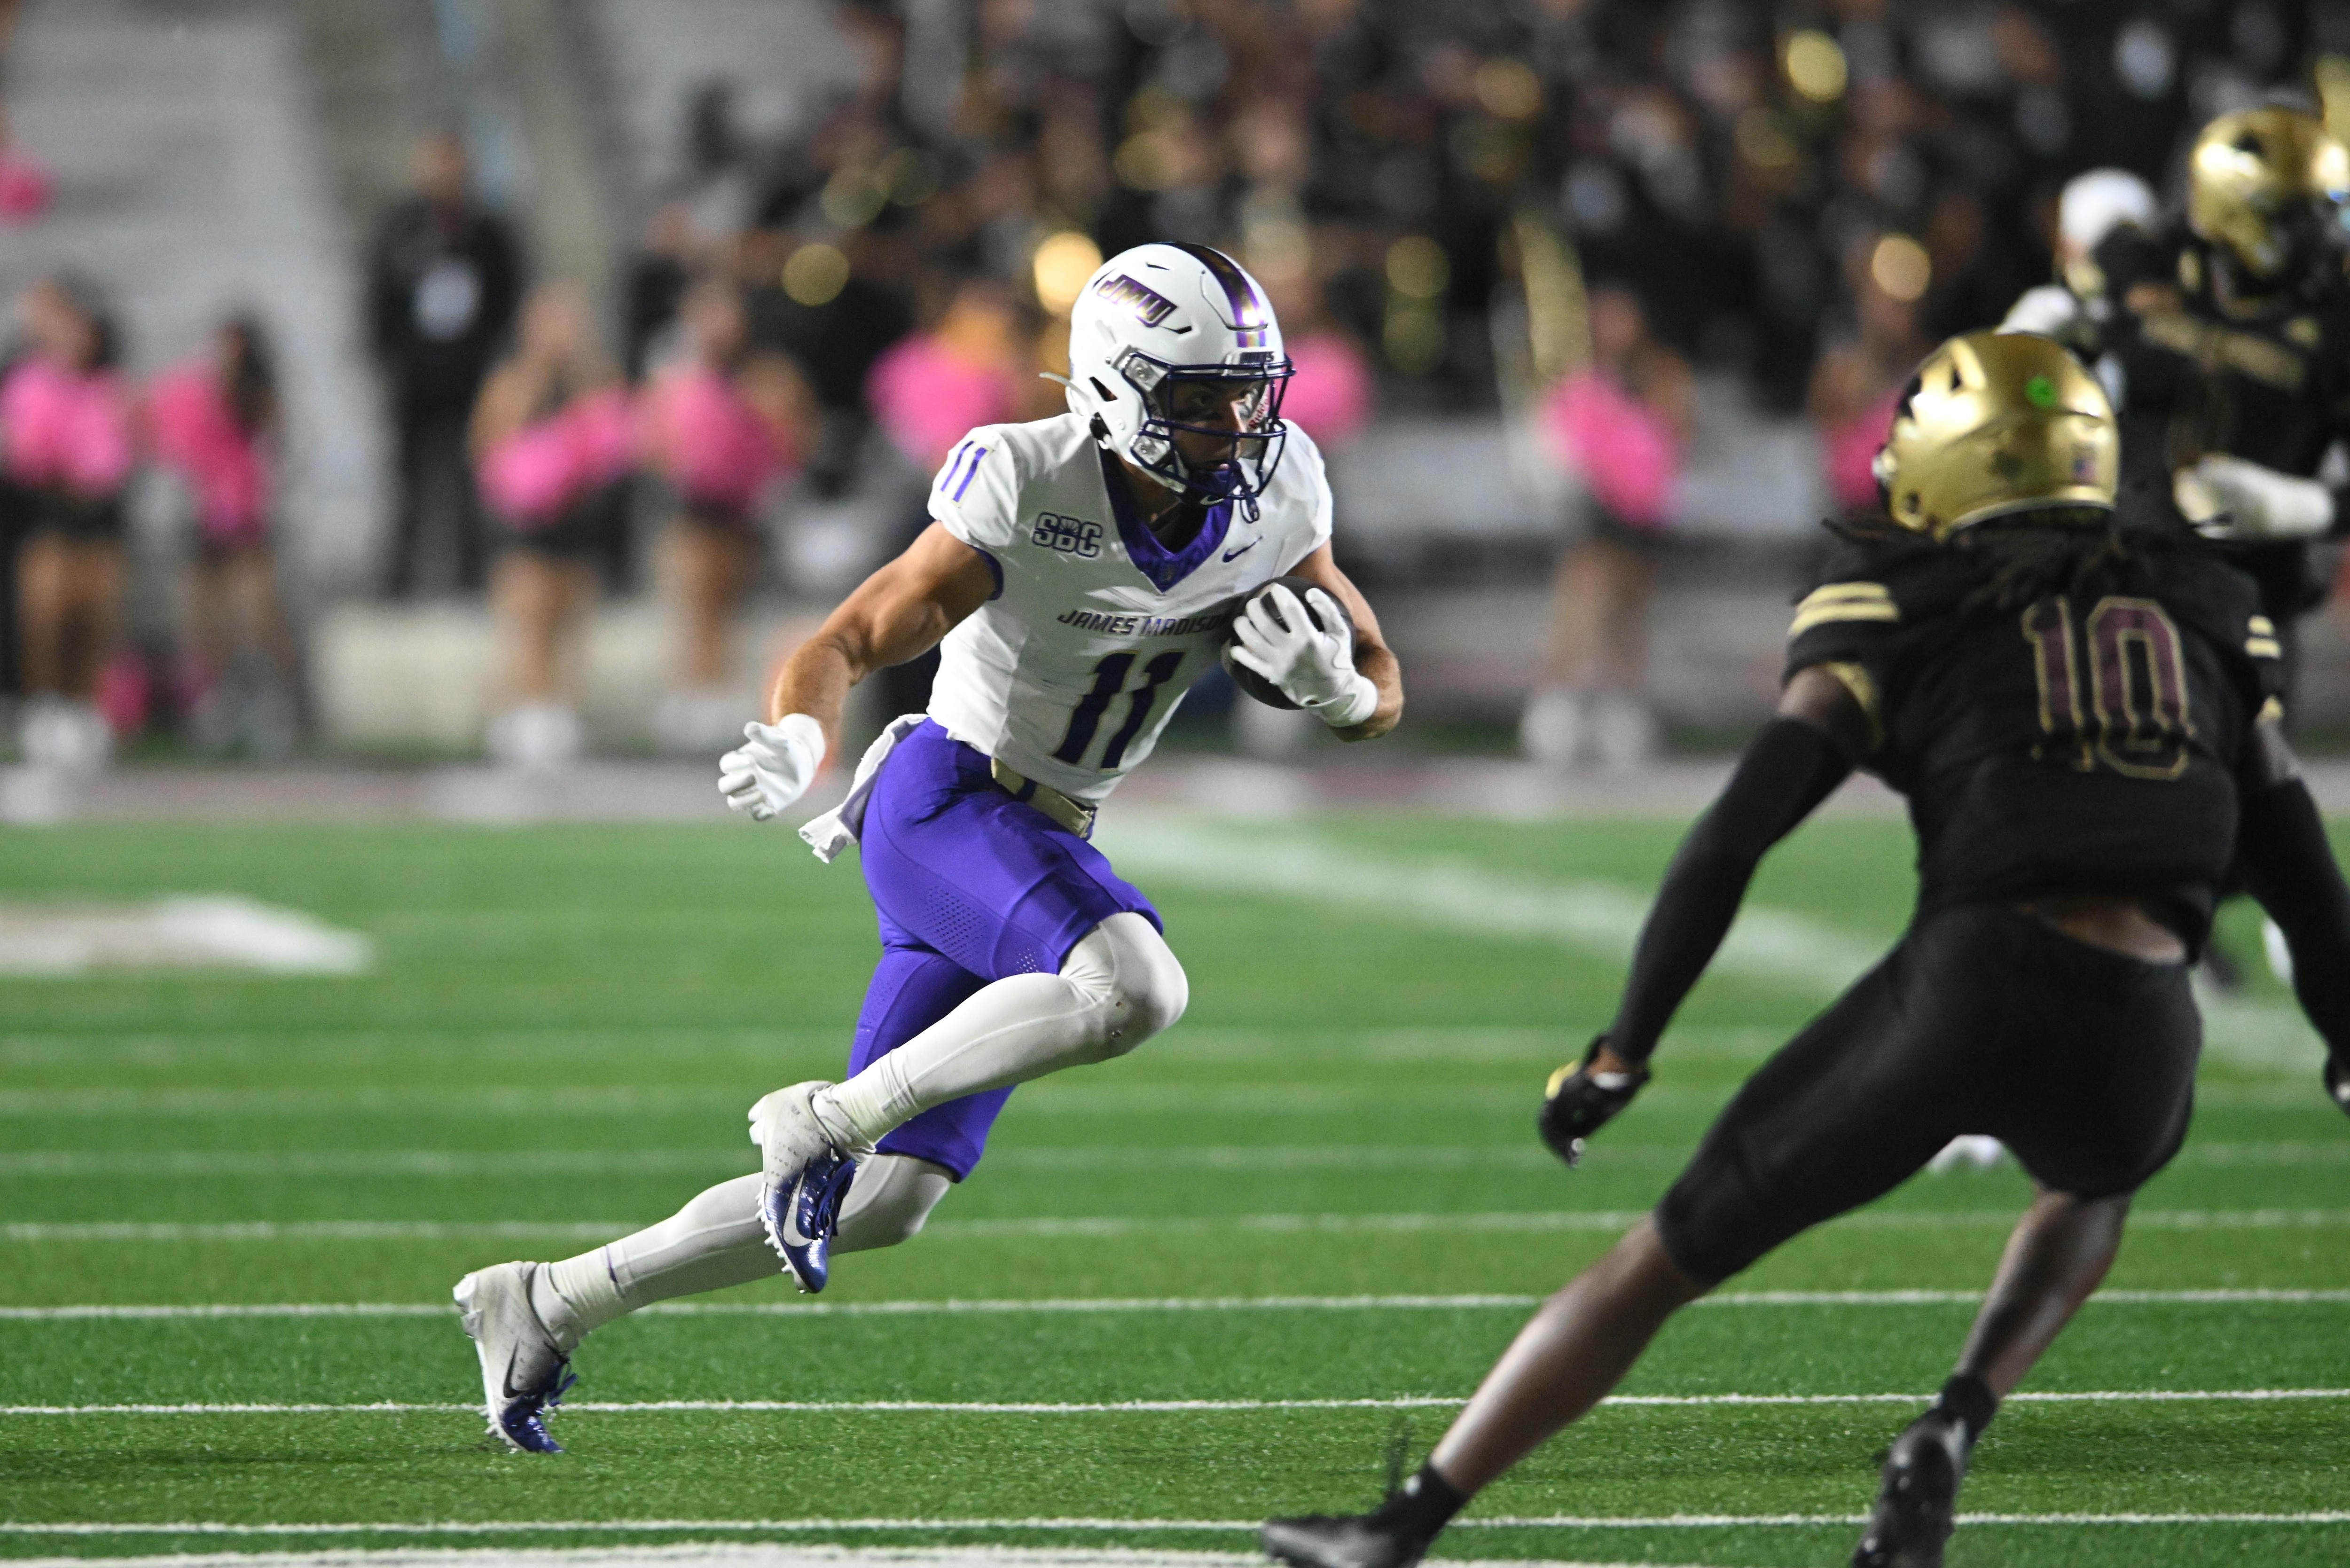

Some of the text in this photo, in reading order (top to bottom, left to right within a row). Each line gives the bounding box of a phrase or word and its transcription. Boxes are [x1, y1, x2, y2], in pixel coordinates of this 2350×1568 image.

[1097, 274, 1177, 328] JMU
[940, 439, 991, 505] 11
[1033, 512, 1103, 557] SBC
[1057, 610, 1139, 635] JAMES
[1051, 650, 1187, 770] 11
[2021, 593, 2195, 780] 10
